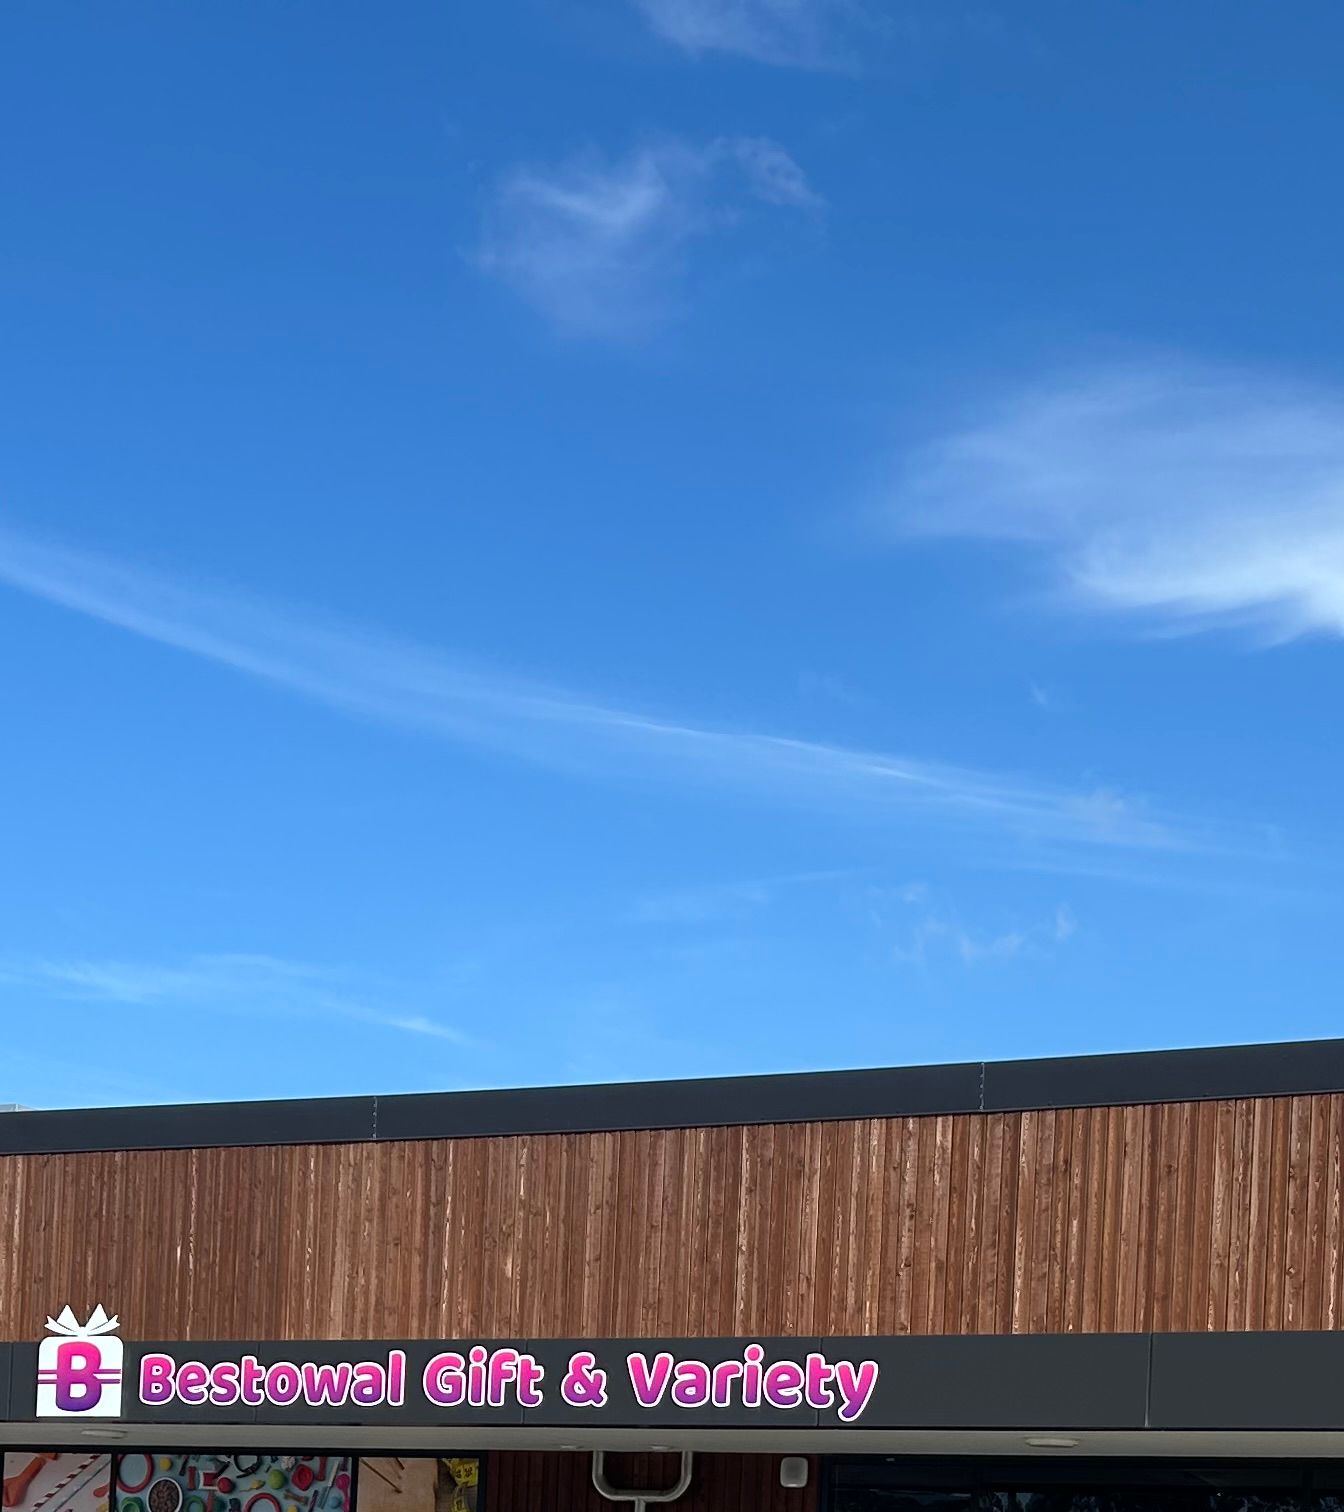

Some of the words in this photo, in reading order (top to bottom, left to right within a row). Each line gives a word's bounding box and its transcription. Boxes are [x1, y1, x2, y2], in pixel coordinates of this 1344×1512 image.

[56, 1341, 102, 1412] B
[139, 1350, 406, 1407] Bestowal
[422, 1346, 545, 1407] Gift
[560, 1352, 608, 1407] &
[626, 1343, 879, 1422] Variety
